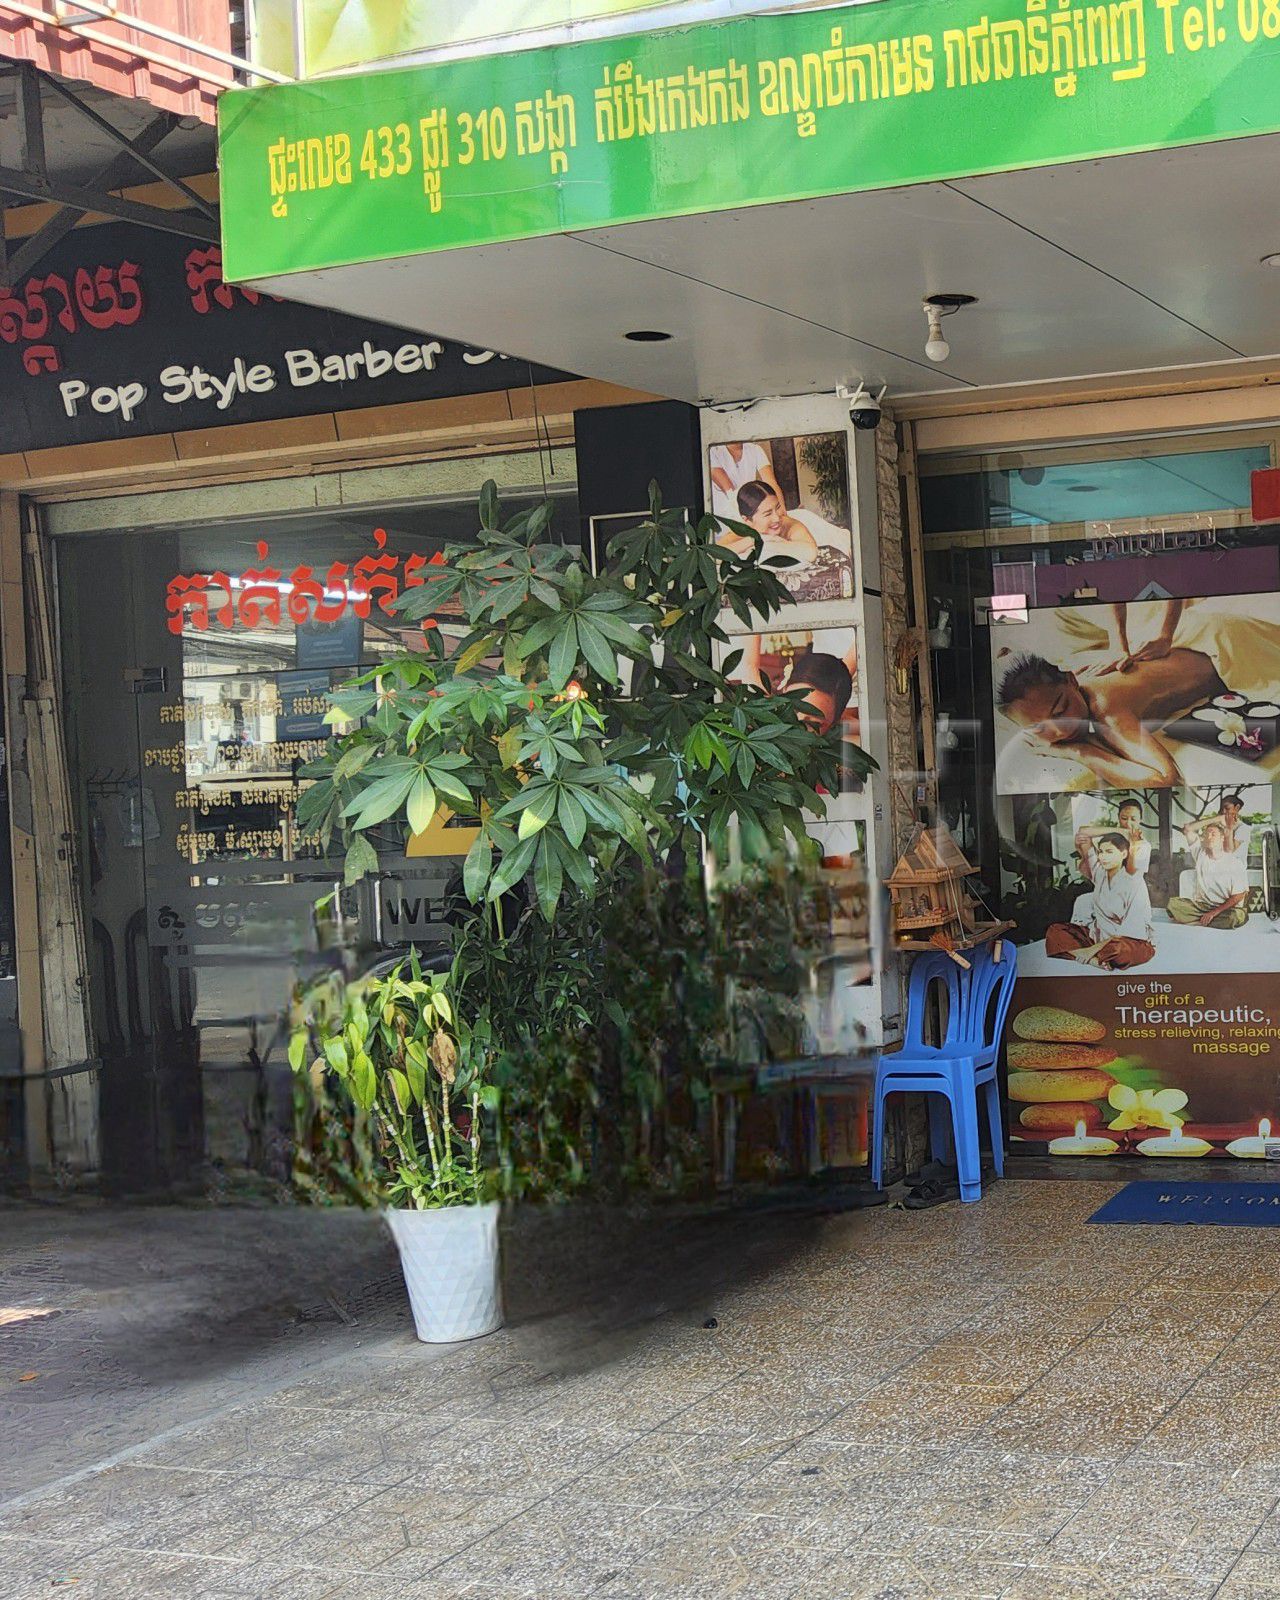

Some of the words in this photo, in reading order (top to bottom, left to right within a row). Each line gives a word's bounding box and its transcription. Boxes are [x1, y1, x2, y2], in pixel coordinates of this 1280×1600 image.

[360, 123, 413, 180] 433
[457, 106, 507, 165] 310
[1156, 0, 1226, 54] Tel:
[59, 379, 148, 421] Pop
[159, 357, 277, 410] Style
[284, 340, 444, 388] Barber
[1117, 982, 1146, 996] give
[1150, 981, 1172, 994] the
[1145, 994, 1170, 1008] gift
[1174, 994, 1191, 1005] of
[1195, 996, 1205, 1005] a
[1115, 1005, 1271, 1027] Therapeutic,
[1114, 1028, 1157, 1039] stress
[1161, 1027, 1225, 1040] relieving,
[1192, 1042, 1271, 1056] massage
